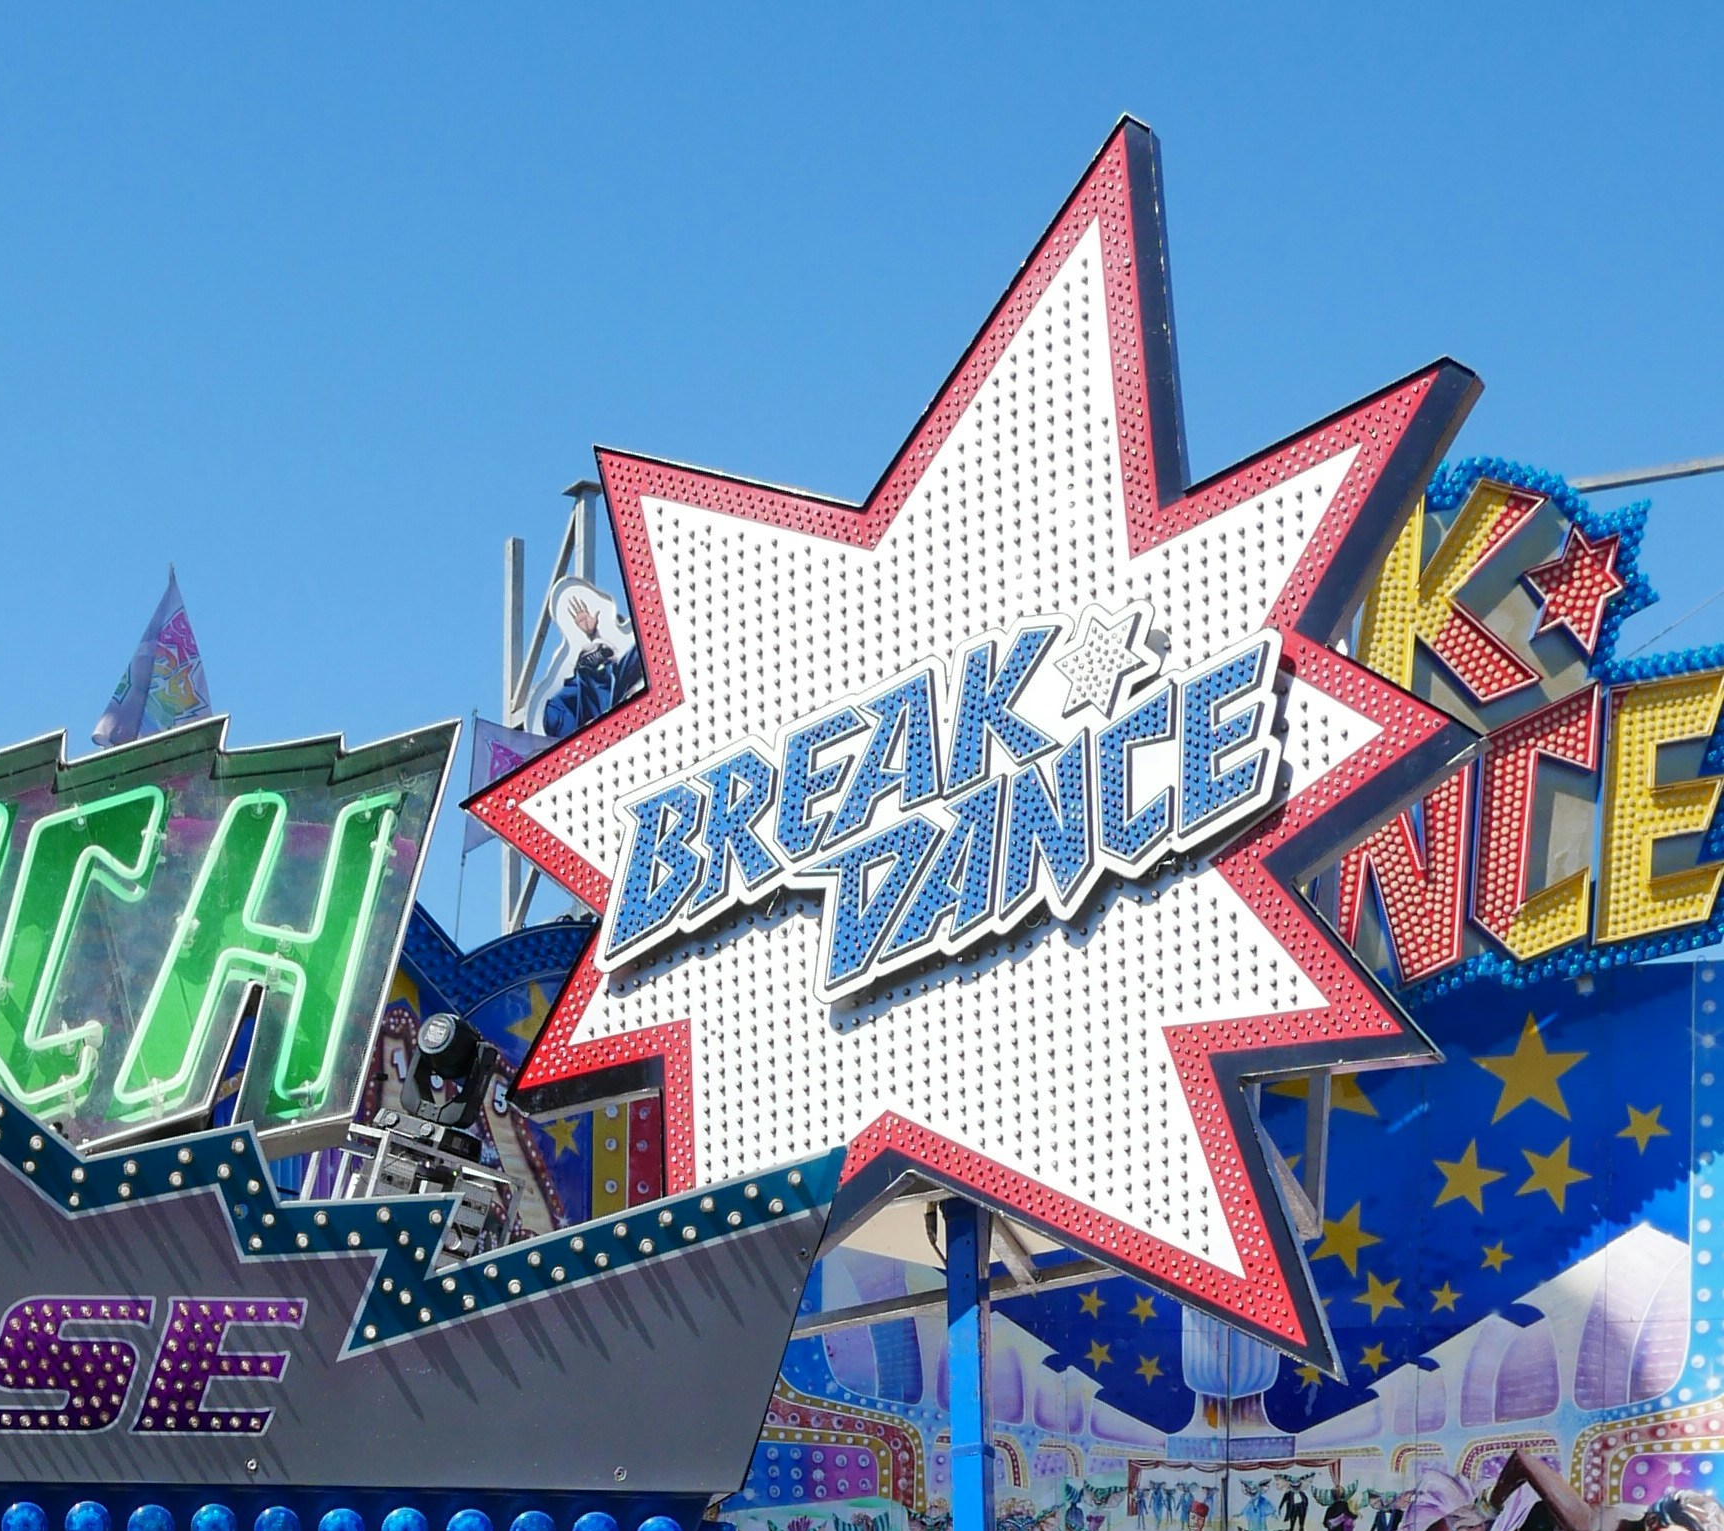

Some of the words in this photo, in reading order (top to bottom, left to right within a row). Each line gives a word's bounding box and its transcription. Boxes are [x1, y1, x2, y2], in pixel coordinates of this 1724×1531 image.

[604, 620, 1070, 970] BREAK
[798, 635, 1280, 998] DANCE
[1334, 669, 1724, 983] NCE
